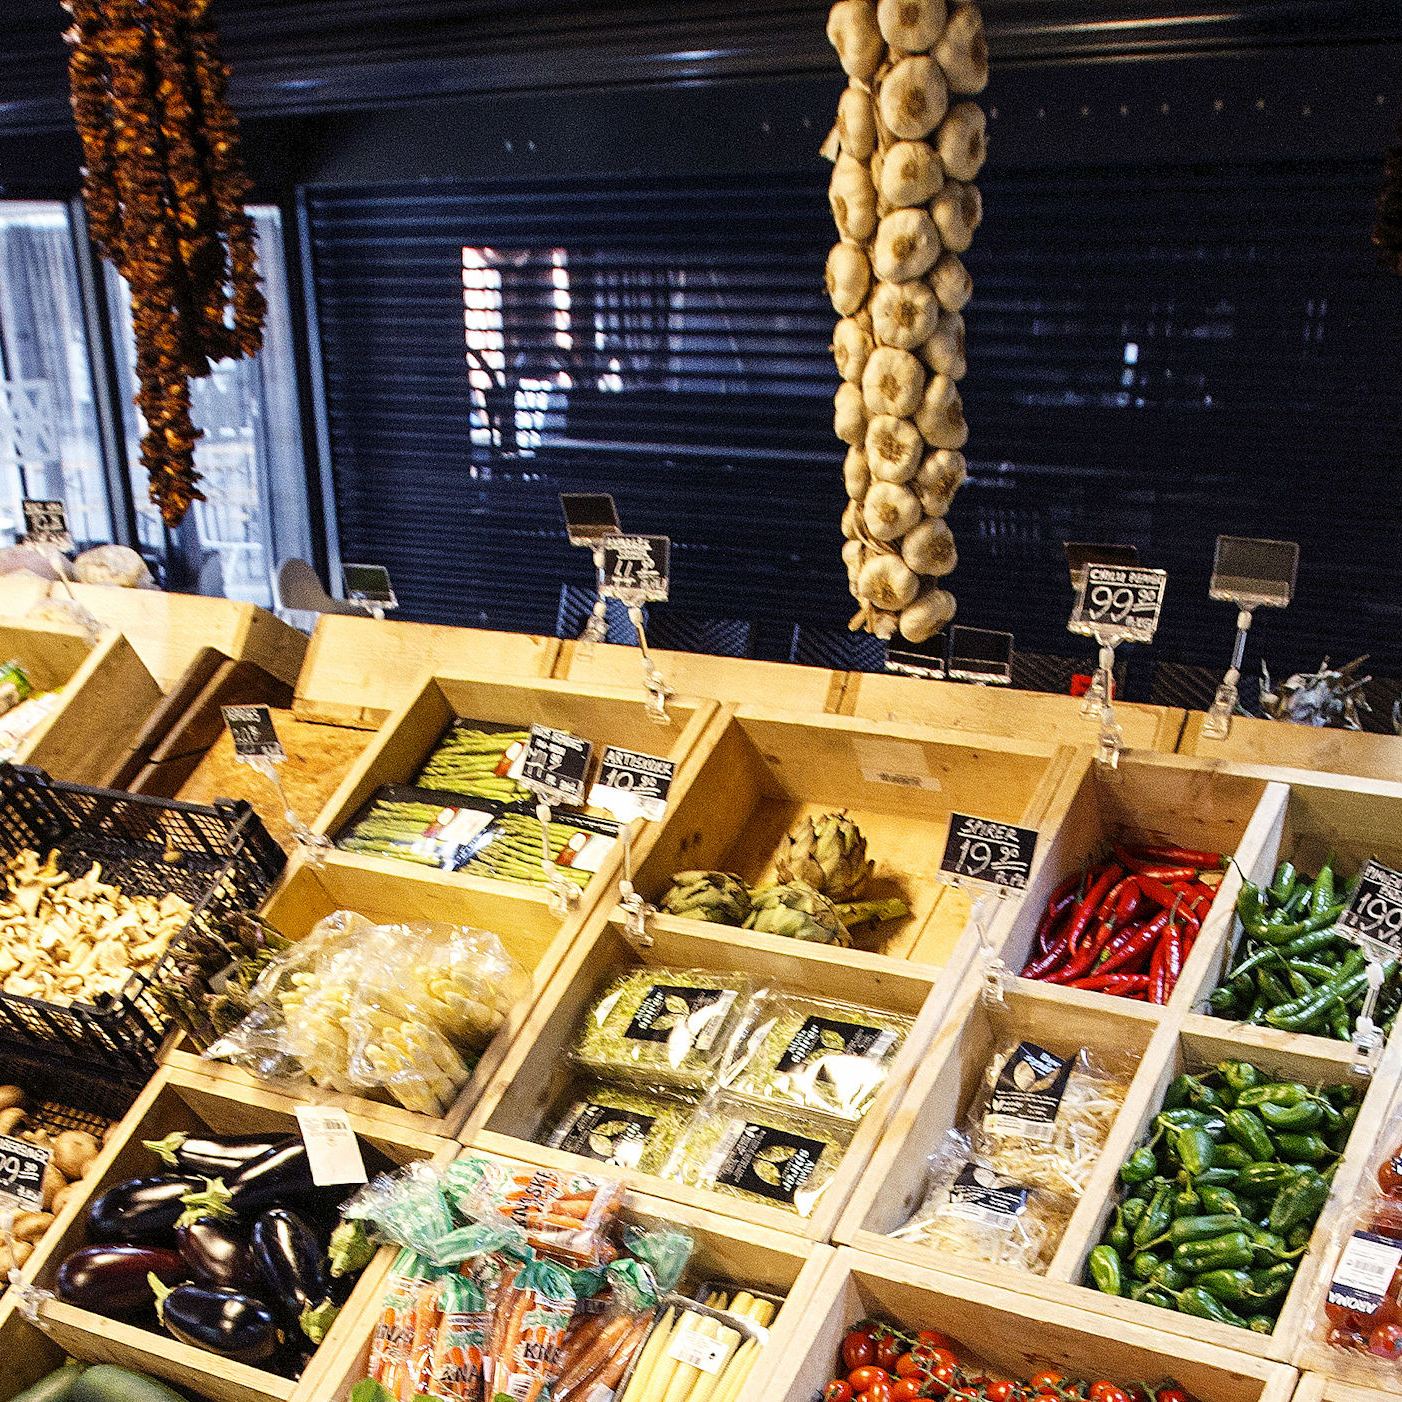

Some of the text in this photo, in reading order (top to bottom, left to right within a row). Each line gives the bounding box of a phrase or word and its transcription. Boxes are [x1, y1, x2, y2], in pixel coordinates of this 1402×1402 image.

[1089, 586, 1134, 623] 99
[955, 838, 992, 875] 19
[1328, 1290, 1379, 1315] AROMA
